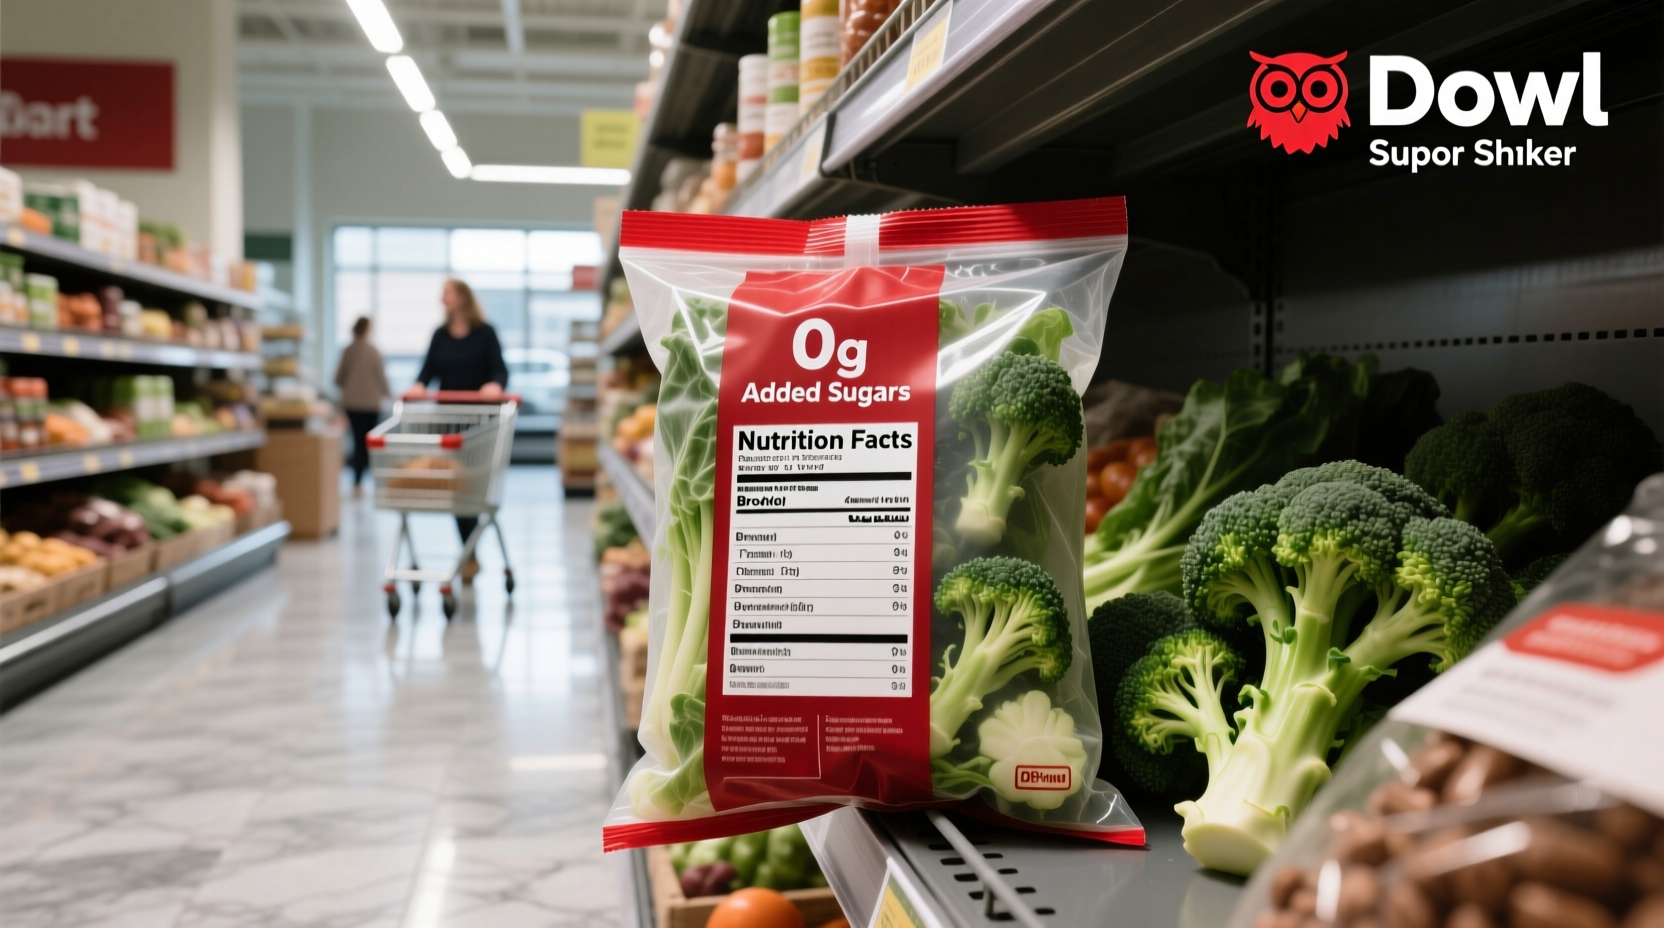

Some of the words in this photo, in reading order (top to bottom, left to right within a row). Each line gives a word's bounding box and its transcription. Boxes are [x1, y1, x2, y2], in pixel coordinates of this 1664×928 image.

[792, 318, 868, 379] 0g
[741, 381, 821, 403] Added
[828, 381, 911, 408] Sugars
[738, 429, 844, 451] Nutrition
[851, 429, 913, 450] Facts
